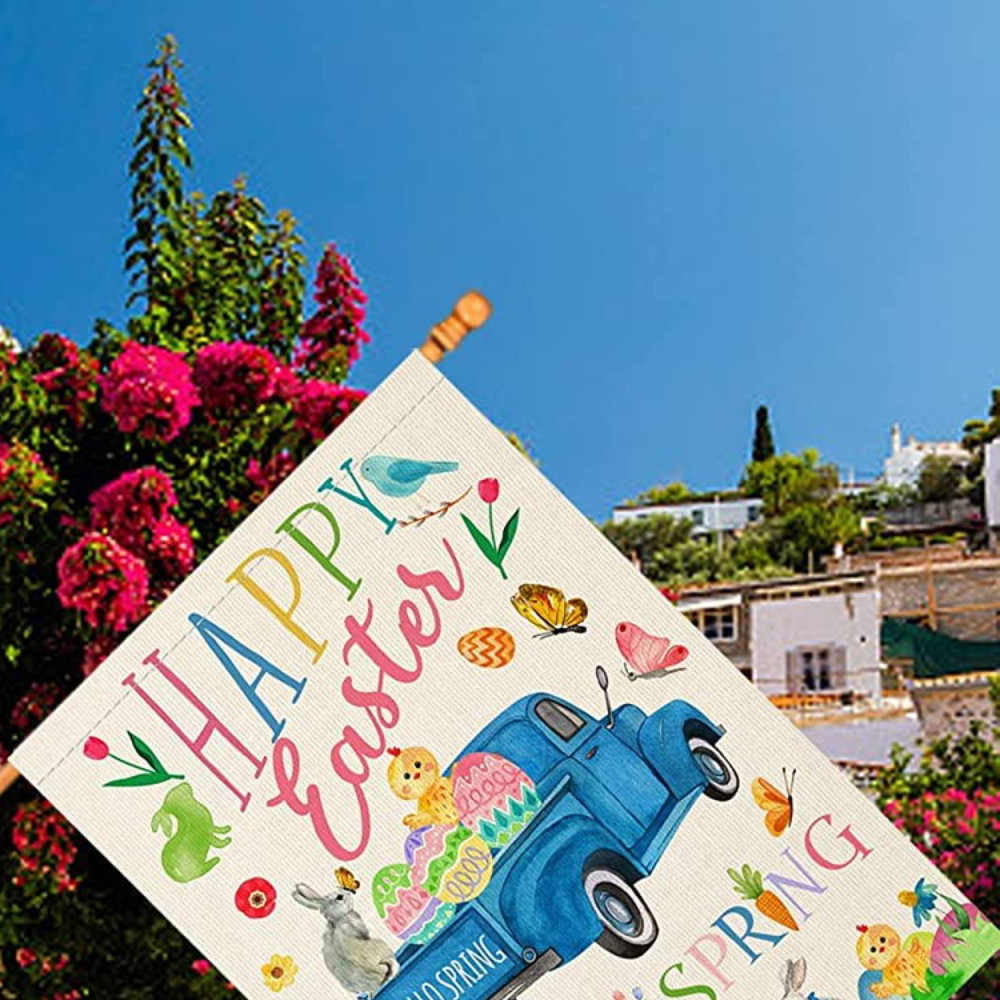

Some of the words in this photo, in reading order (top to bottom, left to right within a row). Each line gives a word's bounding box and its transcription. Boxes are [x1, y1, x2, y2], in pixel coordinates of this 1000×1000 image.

[122, 458, 397, 812] HAPPY
[267, 538, 465, 861] Easter
[435, 934, 508, 1000] SPRING
